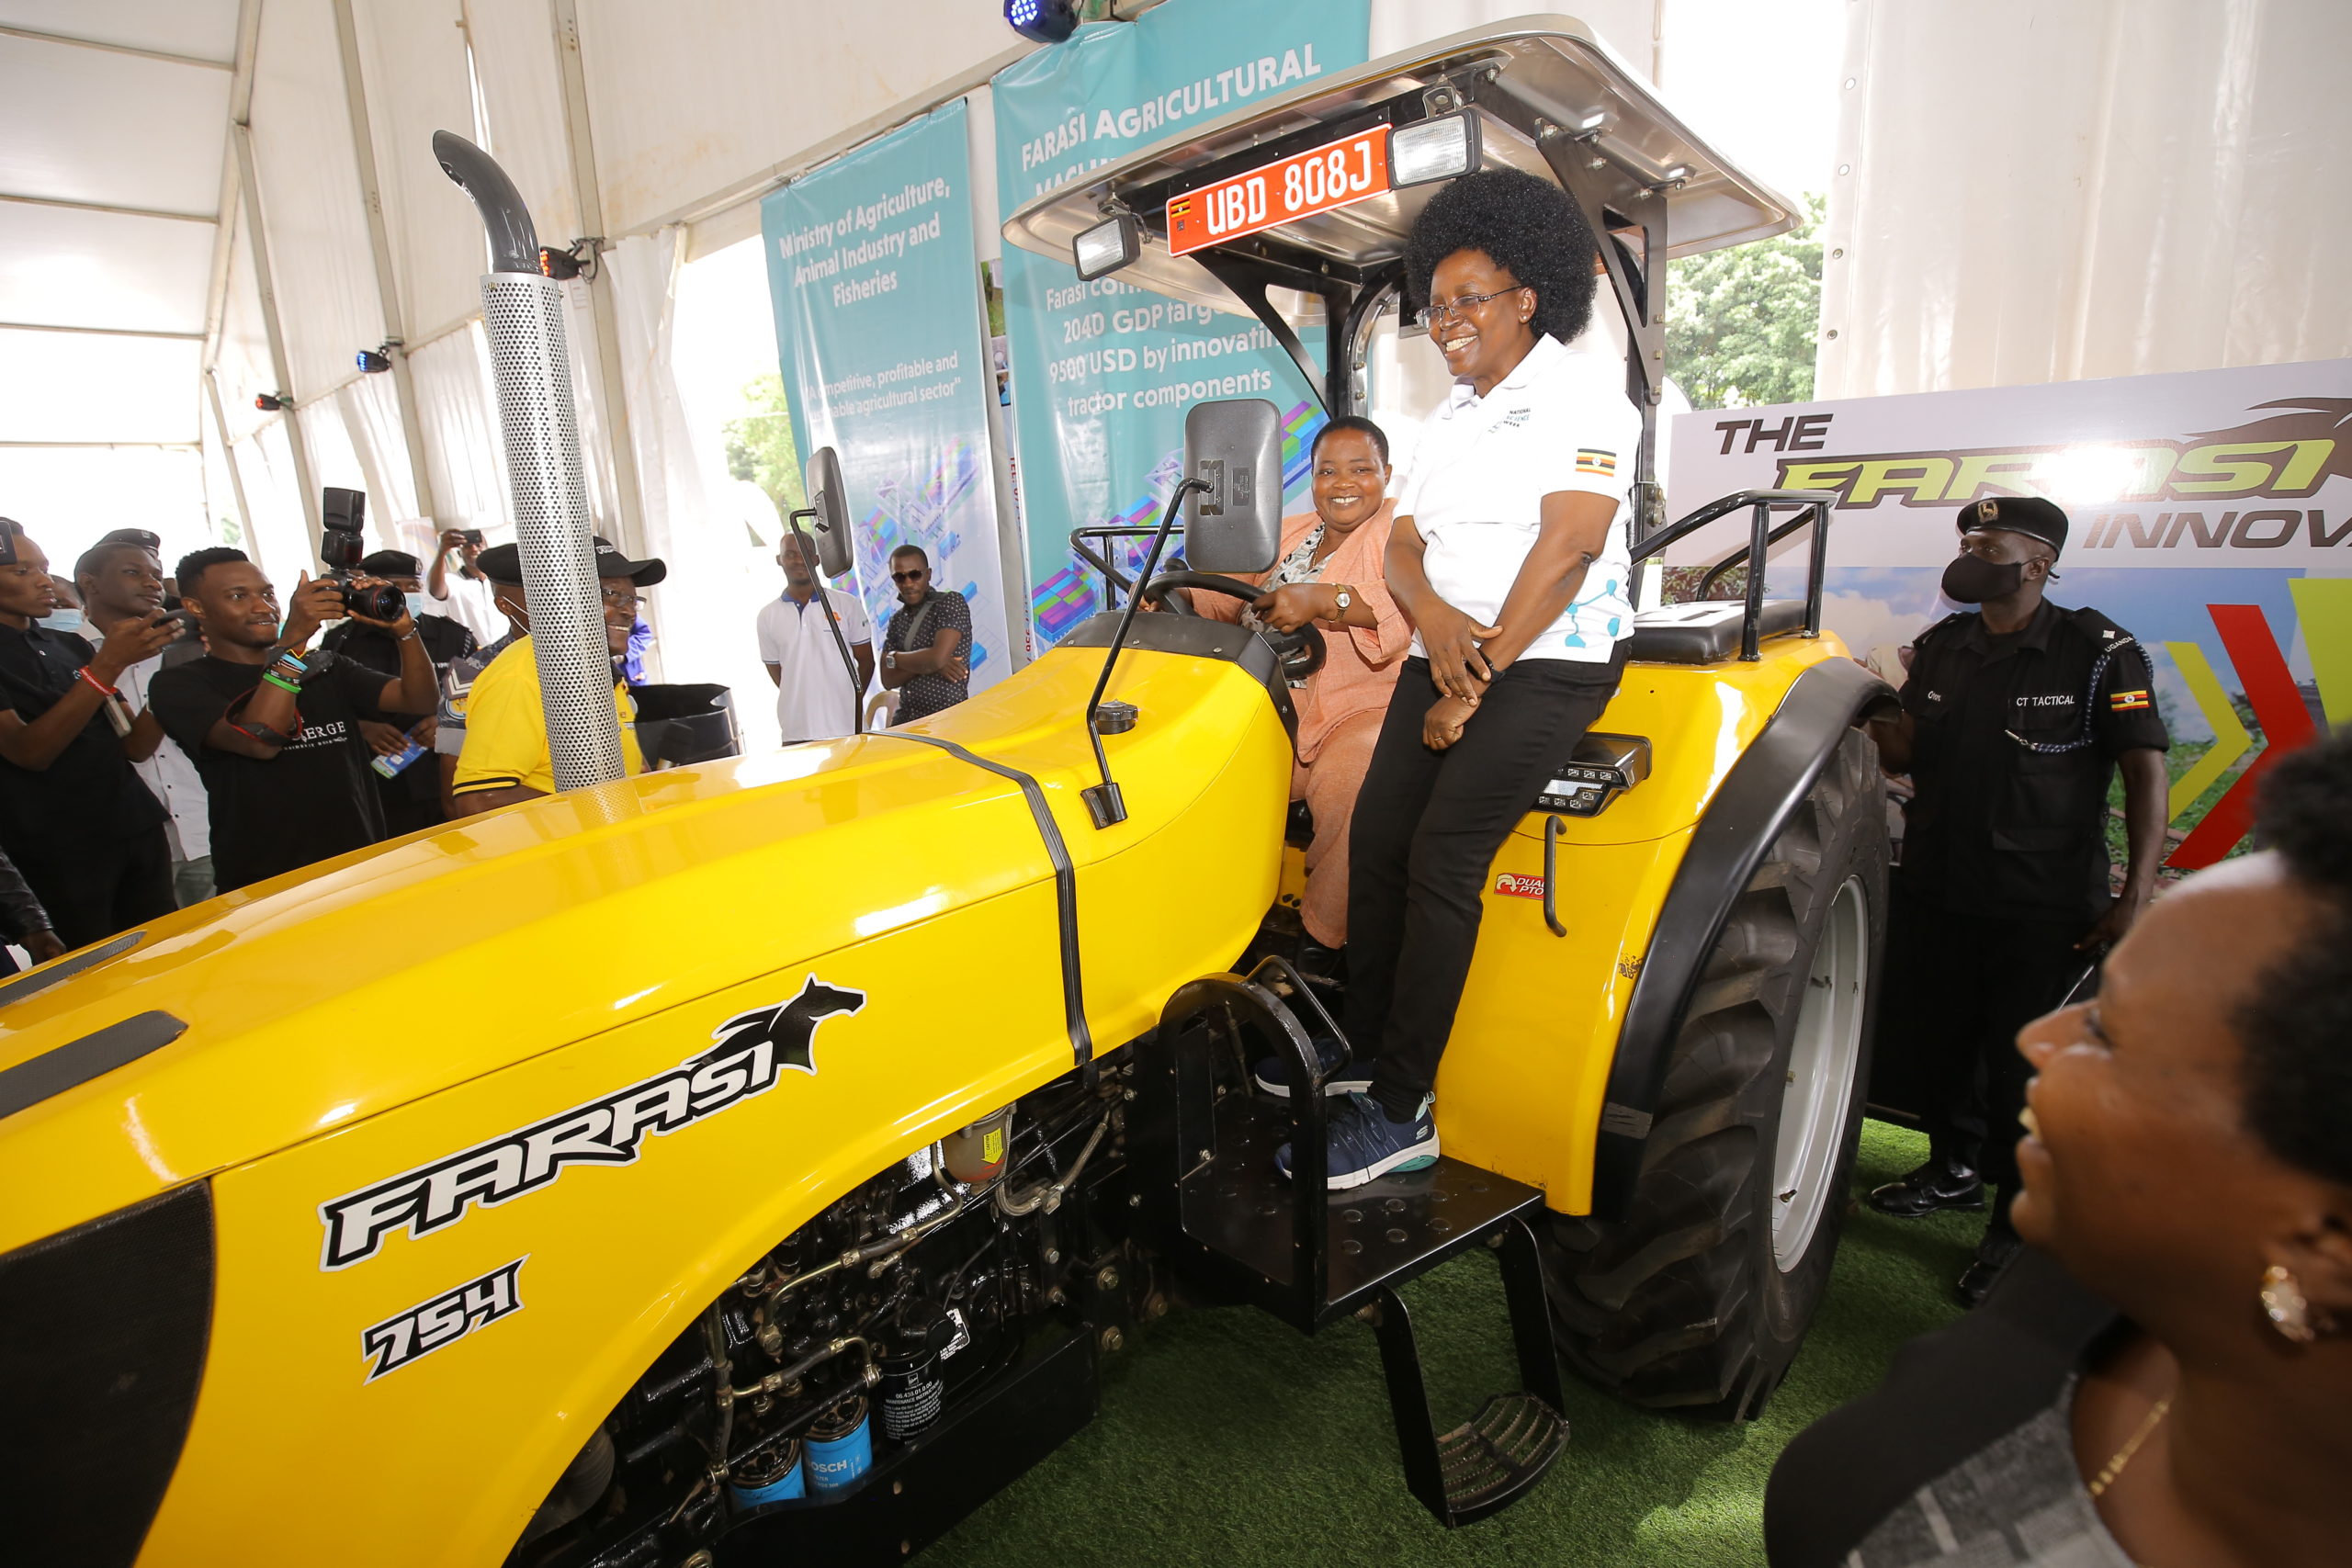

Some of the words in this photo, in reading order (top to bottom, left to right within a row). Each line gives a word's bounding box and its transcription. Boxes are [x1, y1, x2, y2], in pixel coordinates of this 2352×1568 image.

[1022, 113, 1086, 172] FARASI
[1093, 43, 1321, 140] AGRICULTURAL
[1206, 175, 1267, 235] UBD
[1284, 141, 1372, 212] 808J
[779, 224, 834, 258] Ministry
[837, 209, 853, 236] of
[854, 176, 951, 231] Agriculture,
[794, 250, 840, 288] Animal
[842, 230, 905, 270] Industry
[909, 211, 941, 246] and
[832, 270, 898, 308] Fisheries
[1046, 283, 1086, 311] Farasi
[1064, 311, 1104, 344] 2040
[1113, 304, 1163, 333] GDP
[876, 358, 933, 389] profitable
[935, 350, 958, 371] and
[1050, 355, 1086, 384] 9500
[1090, 348, 1137, 375] USD
[1143, 345, 1168, 373] by
[1171, 323, 1282, 363] innovatin
[856, 387, 918, 417] agricultural
[920, 377, 962, 400] sector"
[1068, 391, 1127, 417] tractor
[1133, 368, 1272, 409] components
[1714, 413, 1835, 455] THE
[2083, 510, 2352, 549] INNOV
[2105, 636, 2134, 653] UGANDA
[2016, 696, 2029, 706] CT
[2032, 694, 2075, 706] TACTICAL
[1520, 886, 1544, 896] PTO
[326, 1038, 779, 1266] FARASI
[810, 1460, 848, 1473] OSCH
